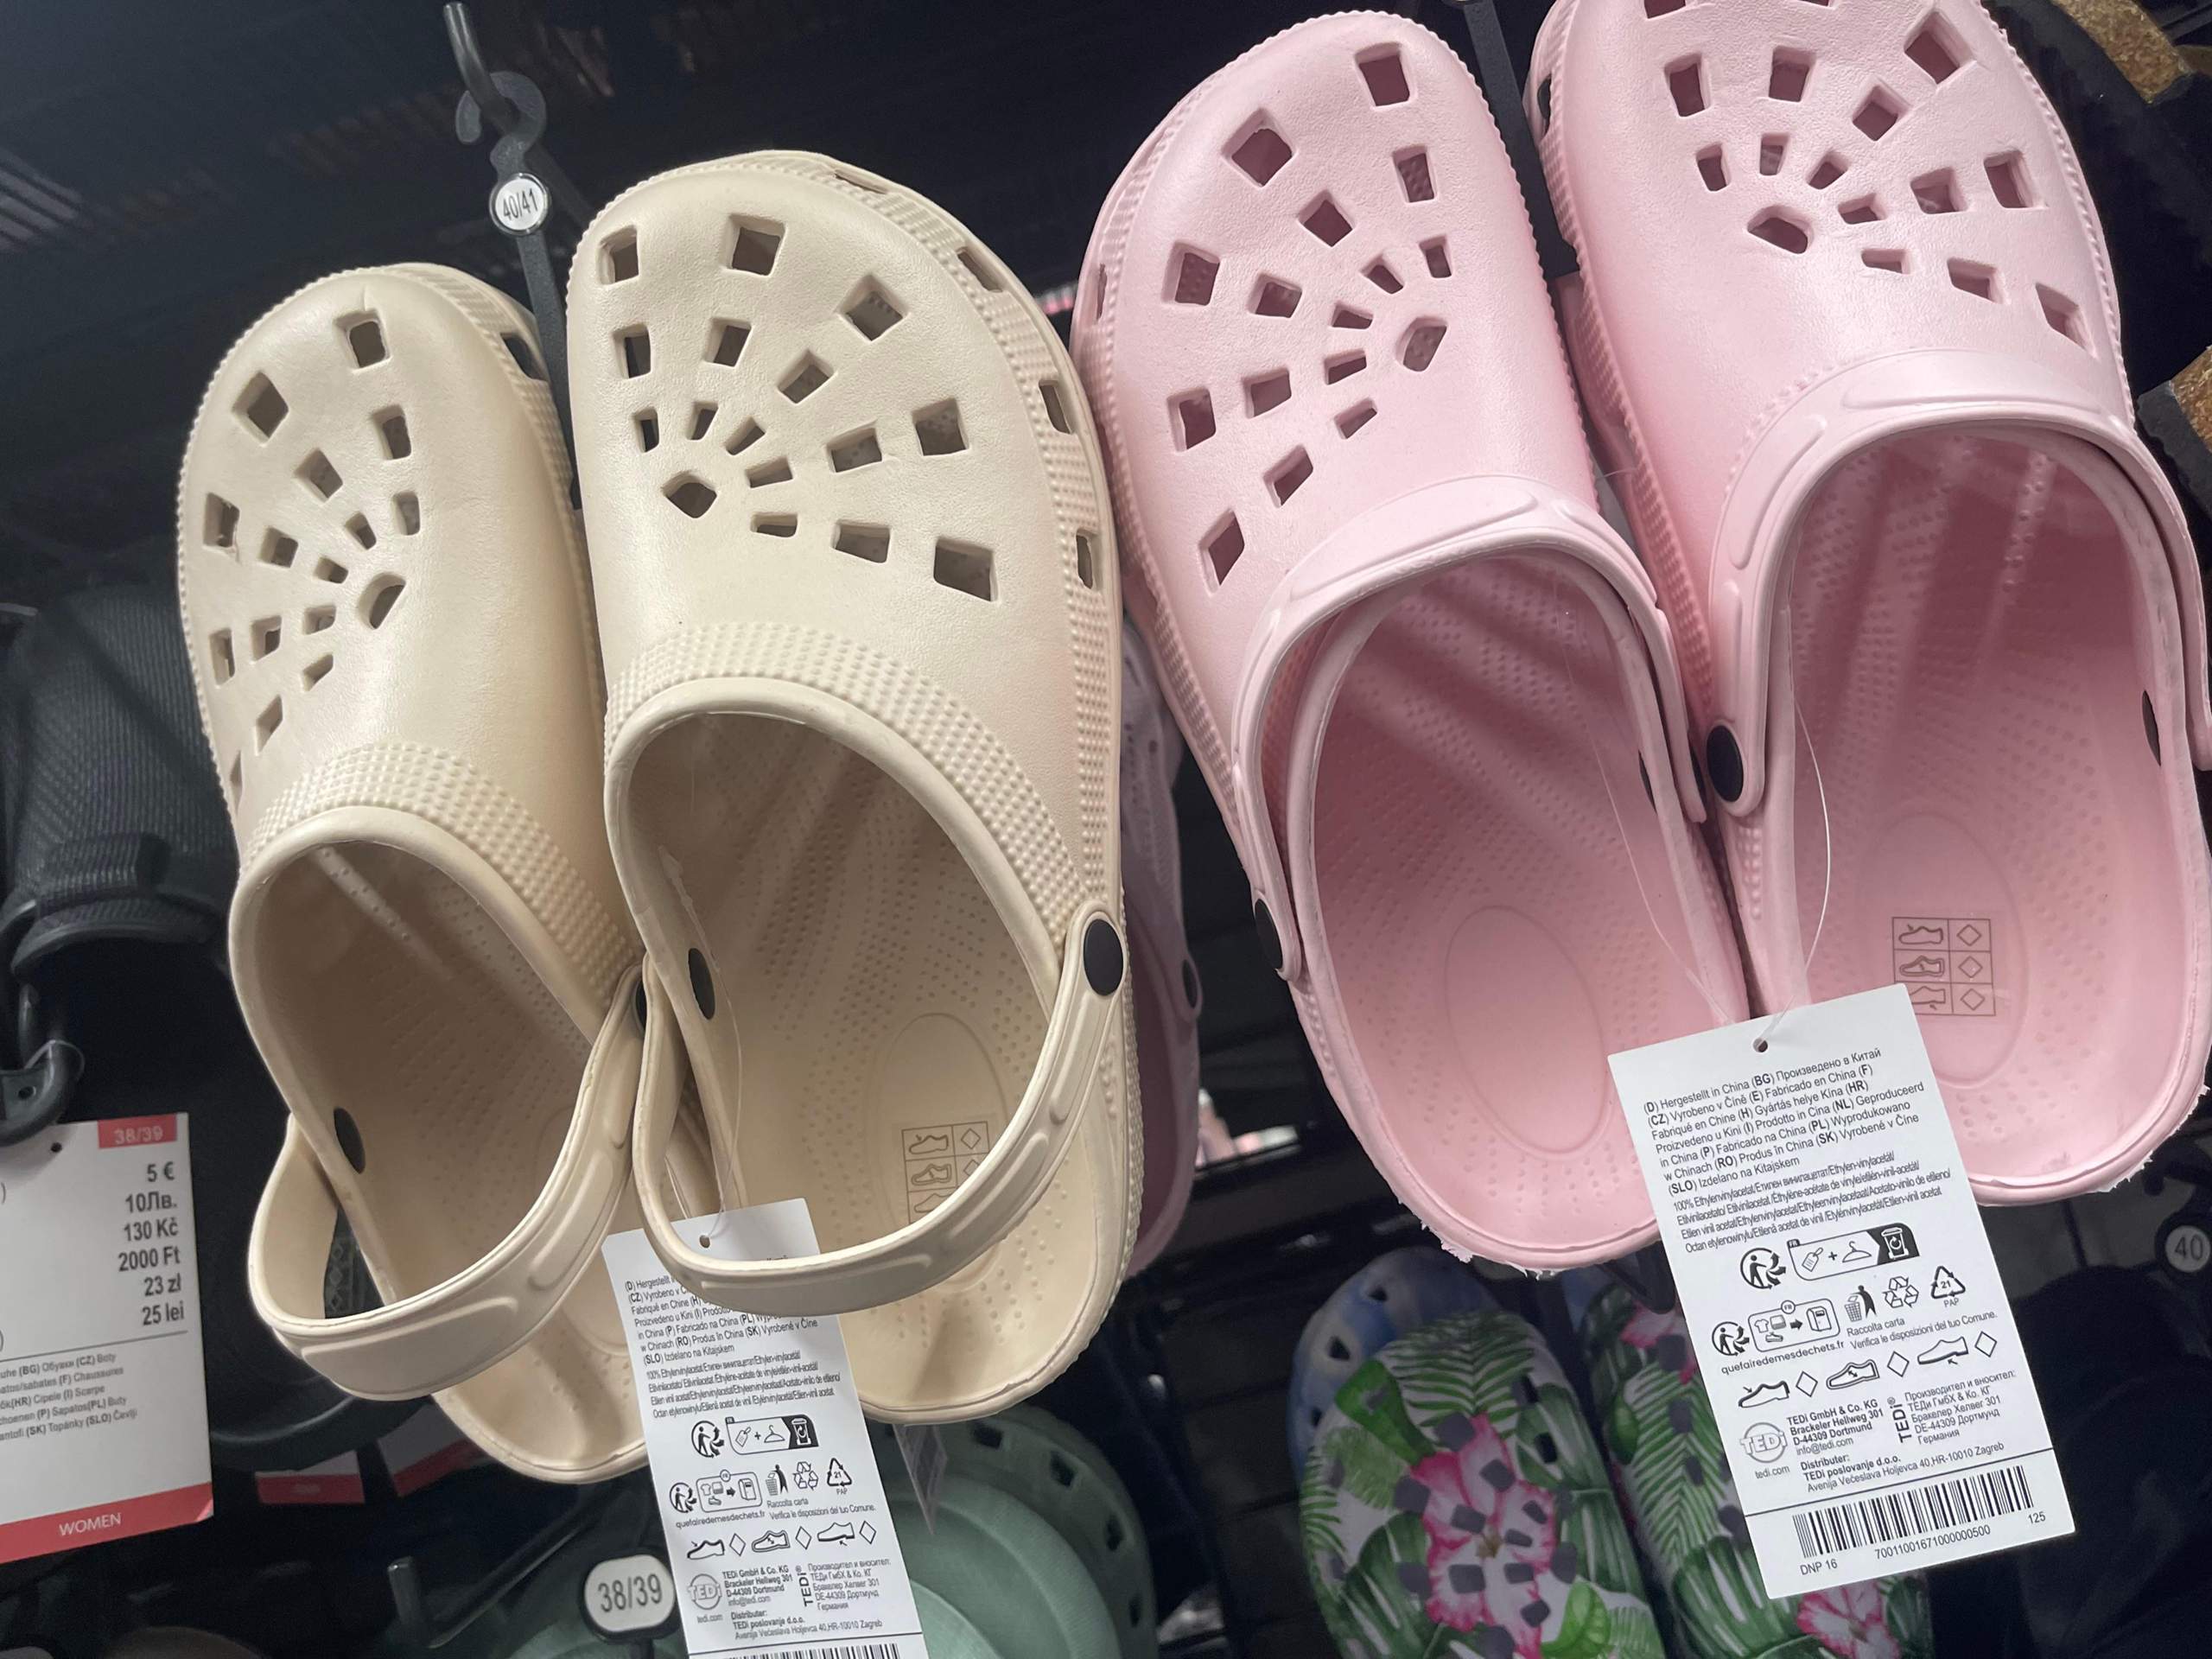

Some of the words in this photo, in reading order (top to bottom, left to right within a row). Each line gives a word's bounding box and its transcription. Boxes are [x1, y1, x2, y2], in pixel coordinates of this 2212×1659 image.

[503, 187, 538, 221] 40/41
[1643, 1101, 1660, 1116] (D)
[1658, 1089, 1711, 1110] Hergestellt
[1710, 1086, 1721, 1098] in
[1721, 1080, 1751, 1097] China
[1751, 1072, 1776, 1090] (BG)
[1775, 1057, 1842, 1083] Произведено
[1842, 1057, 1851, 1069] в
[1850, 1046, 1882, 1065] Китай
[1647, 1112, 1670, 1129] (CZ)
[1669, 1103, 1716, 1122] Vyrobeno
[1715, 1101, 1723, 1110] v
[1748, 1090, 1764, 1105] (E)
[1764, 1078, 1813, 1100] Fabricado
[1813, 1076, 1827, 1087] en
[1827, 1067, 1859, 1084] China
[1858, 1063, 1873, 1079] (F)
[1650, 1121, 1694, 1141] Fabriqué
[1694, 1119, 1708, 1131] en
[1707, 1112, 1737, 1128] Chine
[1737, 1106, 1754, 1122] (H)
[1754, 1098, 1793, 1118] Gyártás
[1791, 1091, 1821, 1107] helye
[1845, 1078, 1870, 1097] (HR)
[1655, 1133, 1715, 1155] Proizvedeno
[1714, 1131, 1723, 1141] u
[1722, 1123, 1743, 1139] Kini
[1741, 1118, 1757, 1136] (I)
[1754, 1112, 1796, 1131] Prodotto
[1795, 1109, 1808, 1121] in
[1807, 1103, 1832, 1118] Cina
[1831, 1096, 1855, 1115] (NL)
[1853, 1080, 1925, 1107] Geproduceerd
[114, 1125, 163, 1145] 38/39
[1658, 1157, 1670, 1168] in
[1669, 1150, 1700, 1166] China
[1700, 1145, 1716, 1160] (P)
[1714, 1135, 1764, 1155] Fabricado
[1764, 1133, 1778, 1144] na
[1777, 1124, 1808, 1141] China
[1808, 1117, 1831, 1135] (PL)
[1829, 1101, 1911, 1128] Wyprodukowano
[1662, 1172, 1673, 1182] w
[1673, 1159, 1714, 1181] Chinach
[1712, 1154, 1738, 1173] (RO)
[1738, 1147, 1774, 1165] Produs
[1784, 1138, 1815, 1153] China
[1813, 1129, 1839, 1148] (SK)
[1838, 1118, 1887, 1141] Vyrobené
[1886, 1119, 1894, 1128] v
[146, 1163, 158, 1183] 5
[163, 1160, 175, 1181] €
[1668, 1179, 1698, 1198] (SLO)
[1697, 1171, 1739, 1189] Izdelano
[1739, 1167, 1753, 1179] na
[1752, 1153, 1801, 1176] Kitajskem
[125, 1191, 178, 1214] 10Лв.
[1673, 1198, 1695, 1212] 100%
[124, 1220, 153, 1242] 130
[156, 1216, 179, 1238] Kč
[118, 1248, 159, 1273] 2000
[163, 1245, 181, 1266] Ft
[2174, 1233, 2204, 1262] 40
[143, 1275, 164, 1297] 23
[1939, 1279, 1952, 1290] 21
[142, 1305, 162, 1326] 25
[166, 1300, 184, 1322] lei
[1942, 1296, 1960, 1309] PAP
[674, 1335, 692, 1350] (RO)
[744, 1325, 762, 1338] (SK)
[1846, 1322, 1884, 1338] Raccolta
[1884, 1317, 1906, 1330] carta
[1849, 1336, 1881, 1351] Verifica
[1878, 1333, 1890, 1344] le
[1889, 1322, 1935, 1342] disposizioni
[1933, 1319, 1948, 1334] del
[1947, 1319, 1961, 1329] tuo
[1961, 1311, 1999, 1327] Comune.
[19, 1363, 41, 1377] (BG)
[76, 1355, 96, 1368] (CZ)
[643, 1353, 664, 1367] (SLO)
[1720, 1339, 1845, 1376] quefairedemesdechets.fr
[59, 1374, 72, 1386] (F)
[1904, 1381, 1967, 1402] Производител
[1966, 1379, 1974, 1390] и
[1906, 1399, 1933, 1413] ТЕДи
[1931, 1392, 1957, 1408] ГмбХ
[1956, 1391, 1966, 1402] &
[1964, 1388, 1980, 1401] Ко.
[1979, 1384, 1991, 1397] КГ
[1910, 1408, 1954, 1425] Бракелер
[1952, 1400, 1984, 1416] Хелвег
[1983, 1394, 2001, 1407] 301
[1785, 1413, 1809, 1427] TEDi
[1808, 1407, 1838, 1422] GmbH
[1838, 1405, 1847, 1416] &
[1847, 1402, 1864, 1414] Co.
[1862, 1398, 1878, 1411] KG
[1789, 1420, 1834, 1439] Brackeler
[1831, 1413, 1870, 1428] Hellweg
[1866, 1407, 1885, 1422] 301
[1913, 1415, 1957, 1438] DE-44309
[1955, 1408, 2001, 1427] Дортмунд
[1792, 1429, 1828, 1447] D-44309
[1827, 1420, 1873, 1440] Dortmund
[1795, 1434, 1854, 1456] info@tedi.com
[1916, 1428, 1961, 1446] Германия
[1754, 1465, 1791, 1479] tedi.com
[1799, 1452, 1851, 1471] Distributer:
[1802, 1468, 1828, 1484] TEDi
[1826, 1459, 1875, 1480] poslovanje
[1875, 1454, 1902, 1468] d.o.o.
[1807, 1476, 1840, 1494] Avenija
[1879, 1461, 1920, 1478] Holjevca
[1974, 1440, 2005, 1459] Zagreb
[59, 1511, 123, 1536] WOMEN
[2025, 1510, 2046, 1525] 125
[1799, 1560, 1823, 1576] DNP
[1824, 1557, 1839, 1570] 16
[597, 1573, 664, 1614] 38/39
